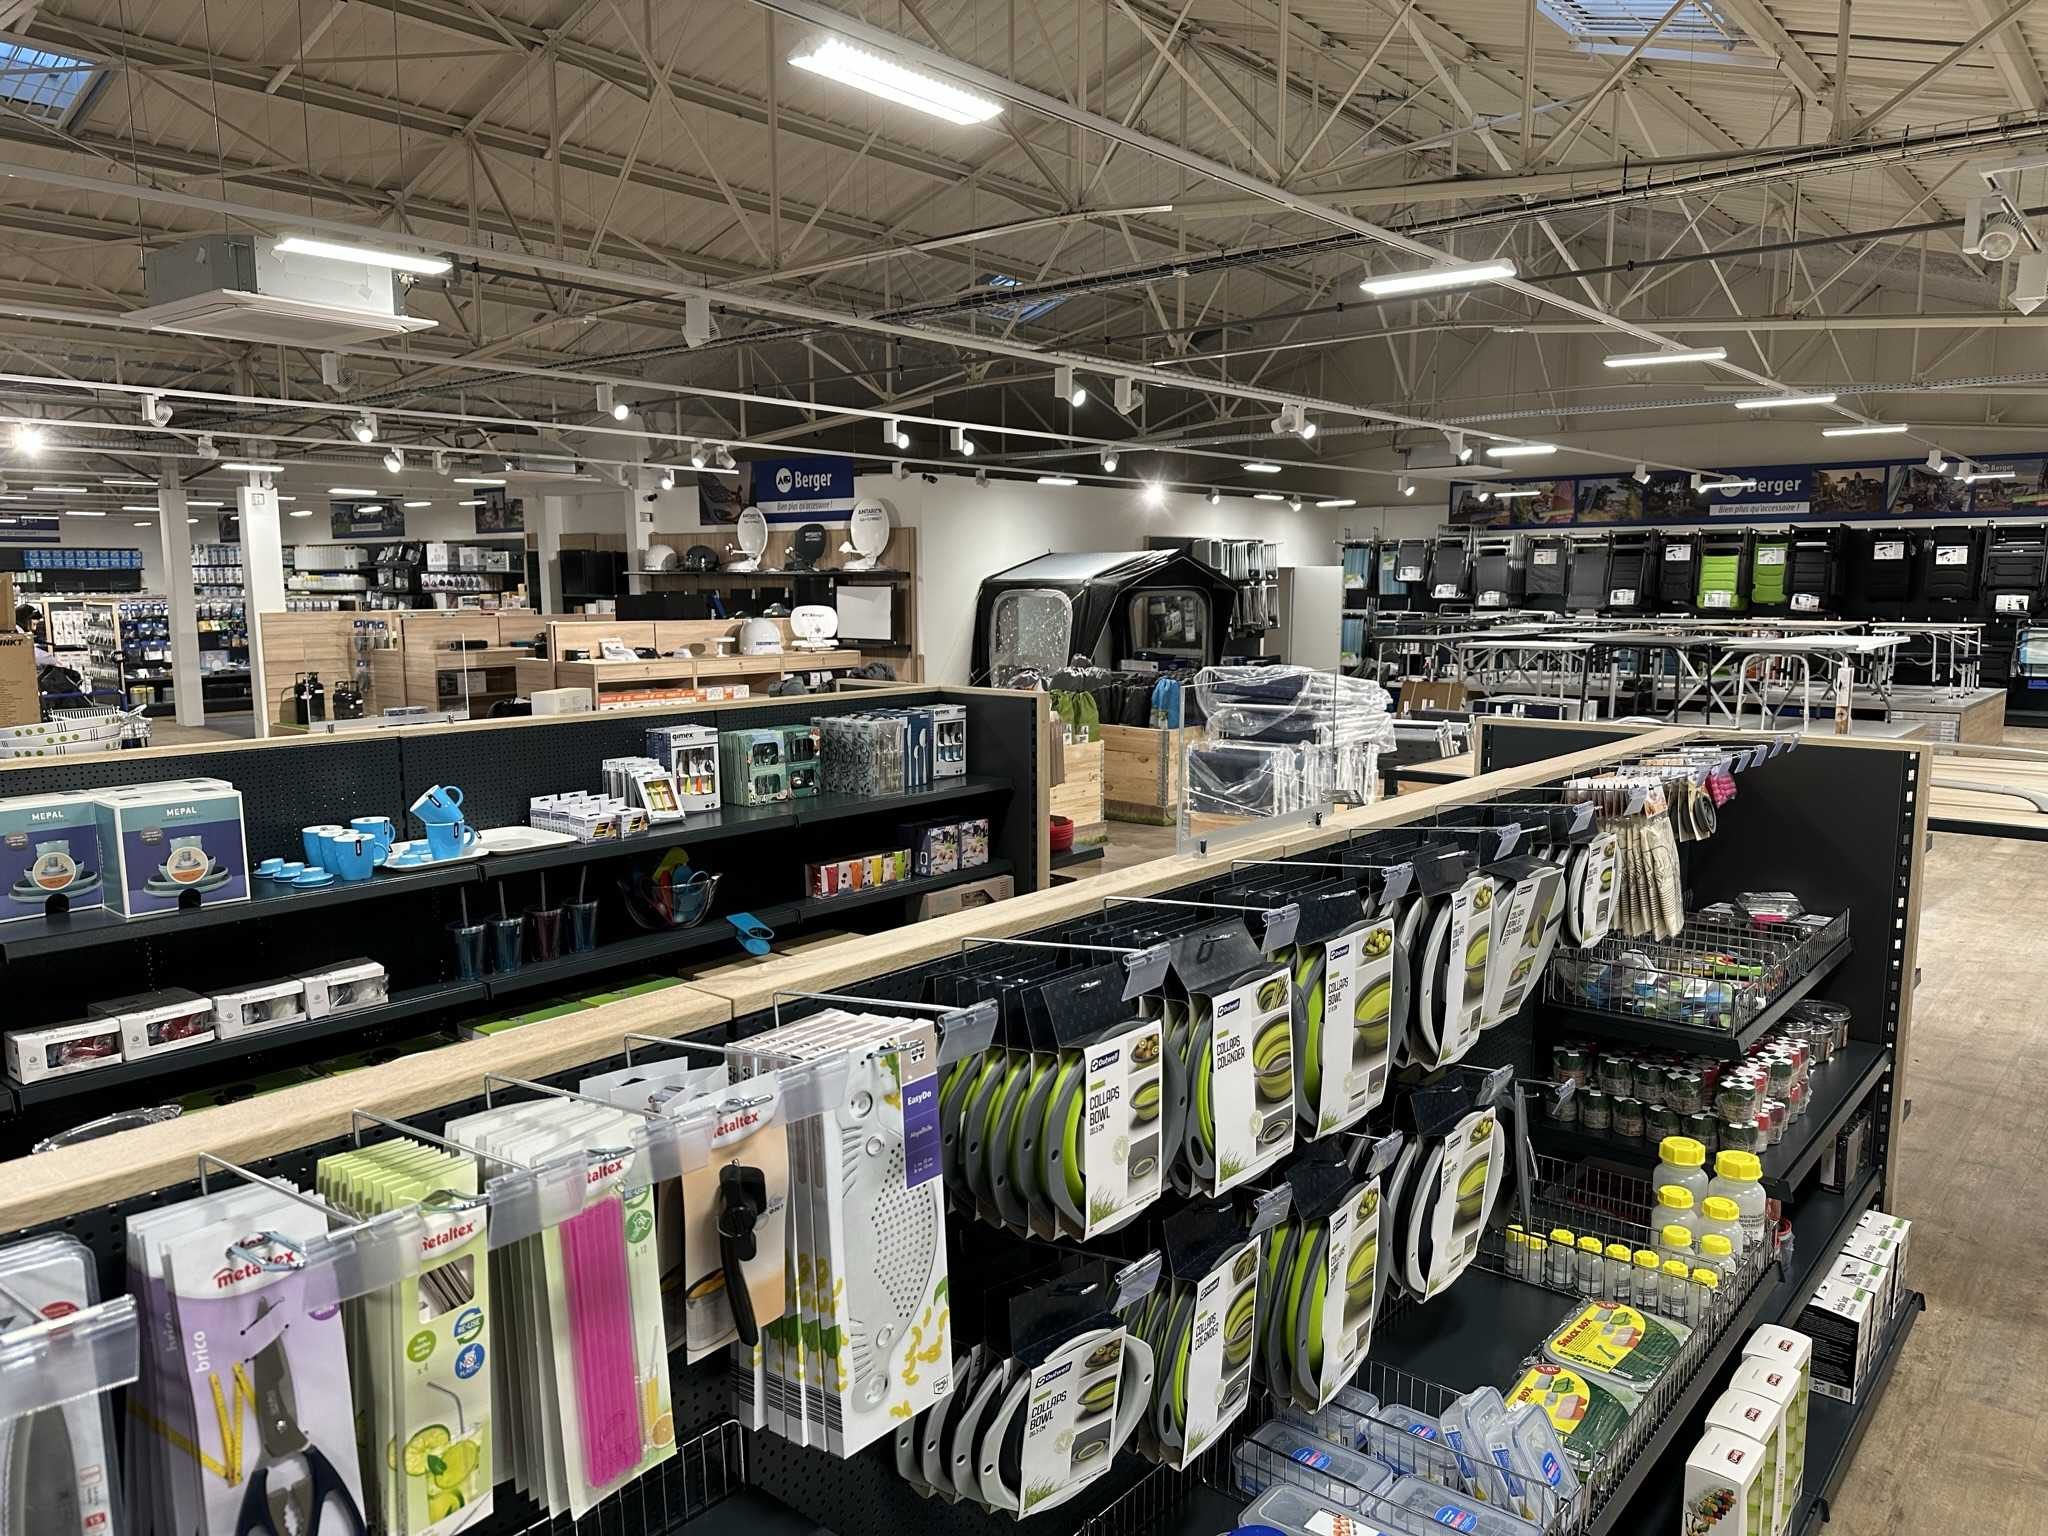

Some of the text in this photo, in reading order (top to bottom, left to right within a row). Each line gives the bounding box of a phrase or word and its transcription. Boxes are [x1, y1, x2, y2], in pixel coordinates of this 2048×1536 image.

[795, 471, 832, 492] Berger
[1747, 478, 1802, 496] Berger
[31, 809, 65, 821] MEPAL
[166, 806, 197, 817] MEPAL
[1328, 976, 1349, 994] COLLAPS
[1217, 1035, 1241, 1057] COLLAPS
[1098, 1051, 1119, 1068] Outwell
[1217, 1047, 1245, 1070] COLANDER
[907, 1090, 932, 1106] EasyDo
[1089, 1086, 1120, 1110] COLLAPS
[713, 1111, 759, 1138] etaltex
[1089, 1108, 1111, 1126] BOWL
[586, 1159, 623, 1184] taltex
[214, 1250, 296, 1289] metaex
[1195, 1312, 1217, 1337] COLLAPS
[1556, 1317, 1593, 1347] SNACK BOX
[1195, 1323, 1220, 1351] COLANDER
[195, 1330, 210, 1373] brico
[1045, 1363, 1071, 1383] Outwell
[1031, 1390, 1068, 1418] COLLAPS
[1517, 1386, 1534, 1402] BOX
[1029, 1410, 1055, 1431] BOWL
